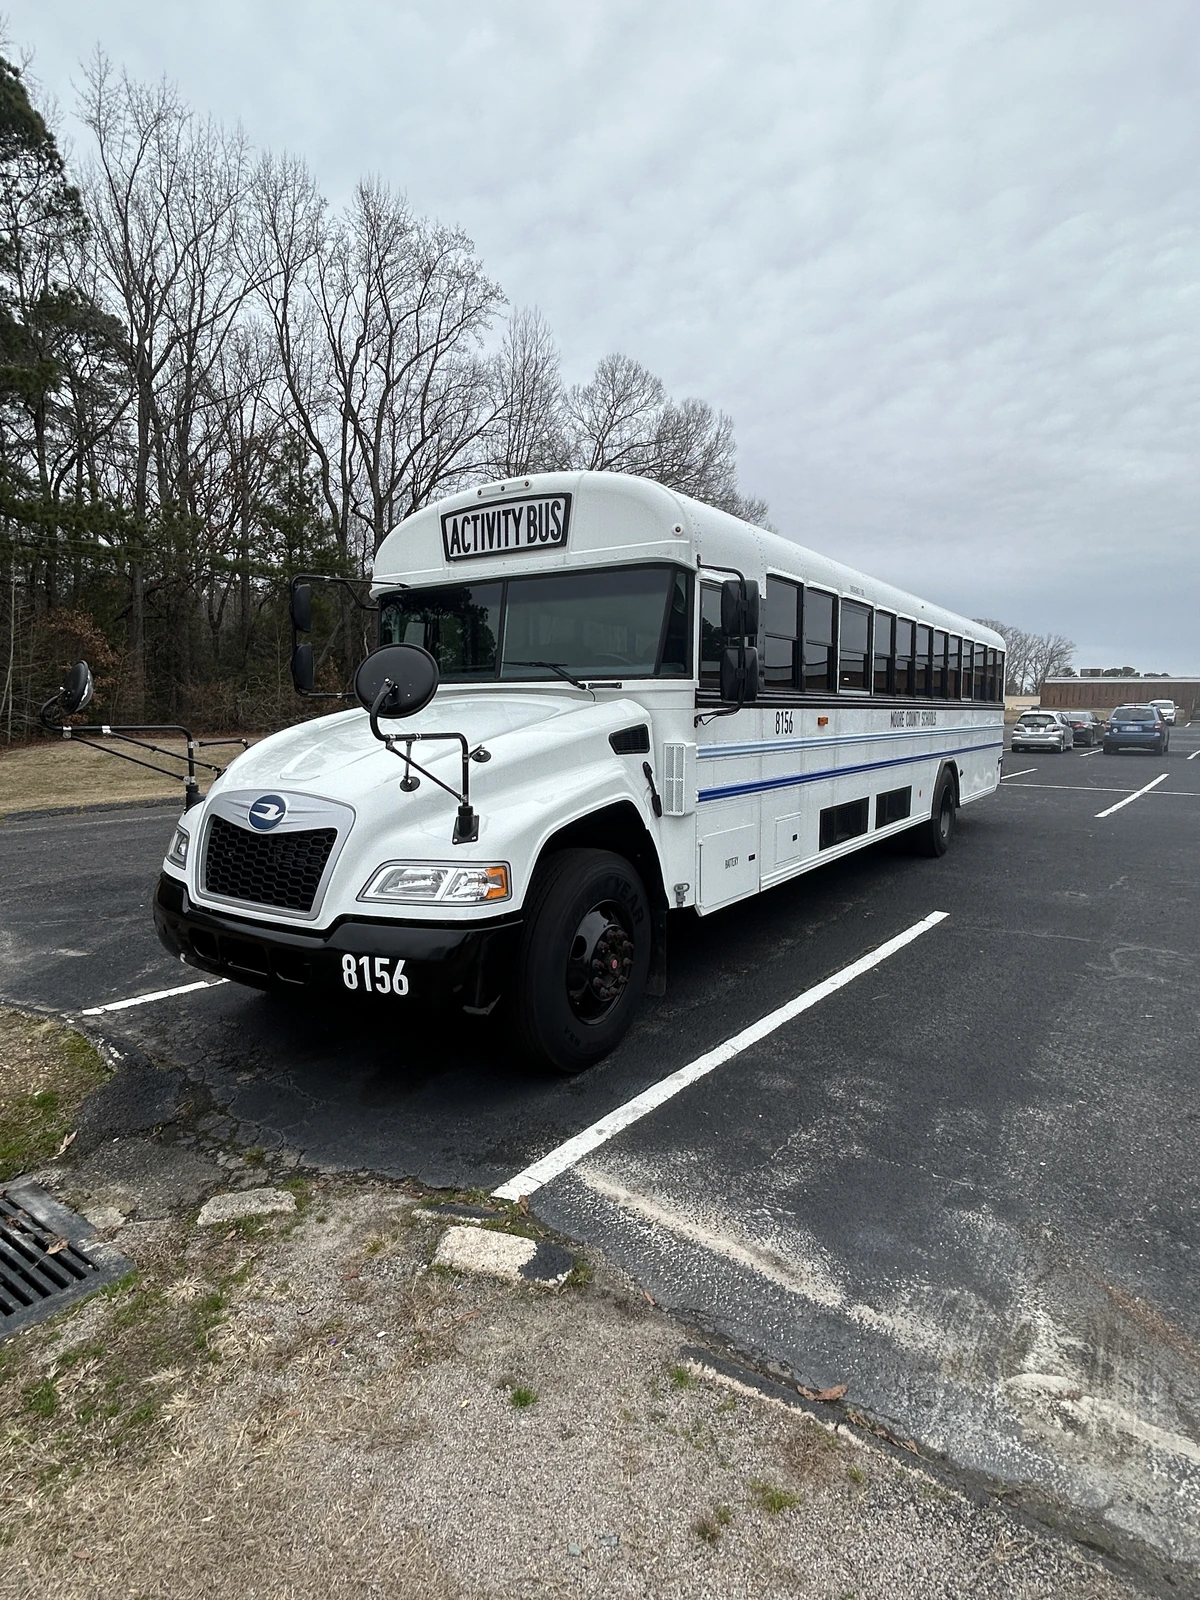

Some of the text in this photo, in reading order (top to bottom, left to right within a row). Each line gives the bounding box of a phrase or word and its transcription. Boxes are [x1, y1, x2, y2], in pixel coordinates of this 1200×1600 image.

[450, 500, 562, 554] ACTIVITY BUS
[775, 711, 793, 735] 8156
[341, 953, 409, 996] 8156
